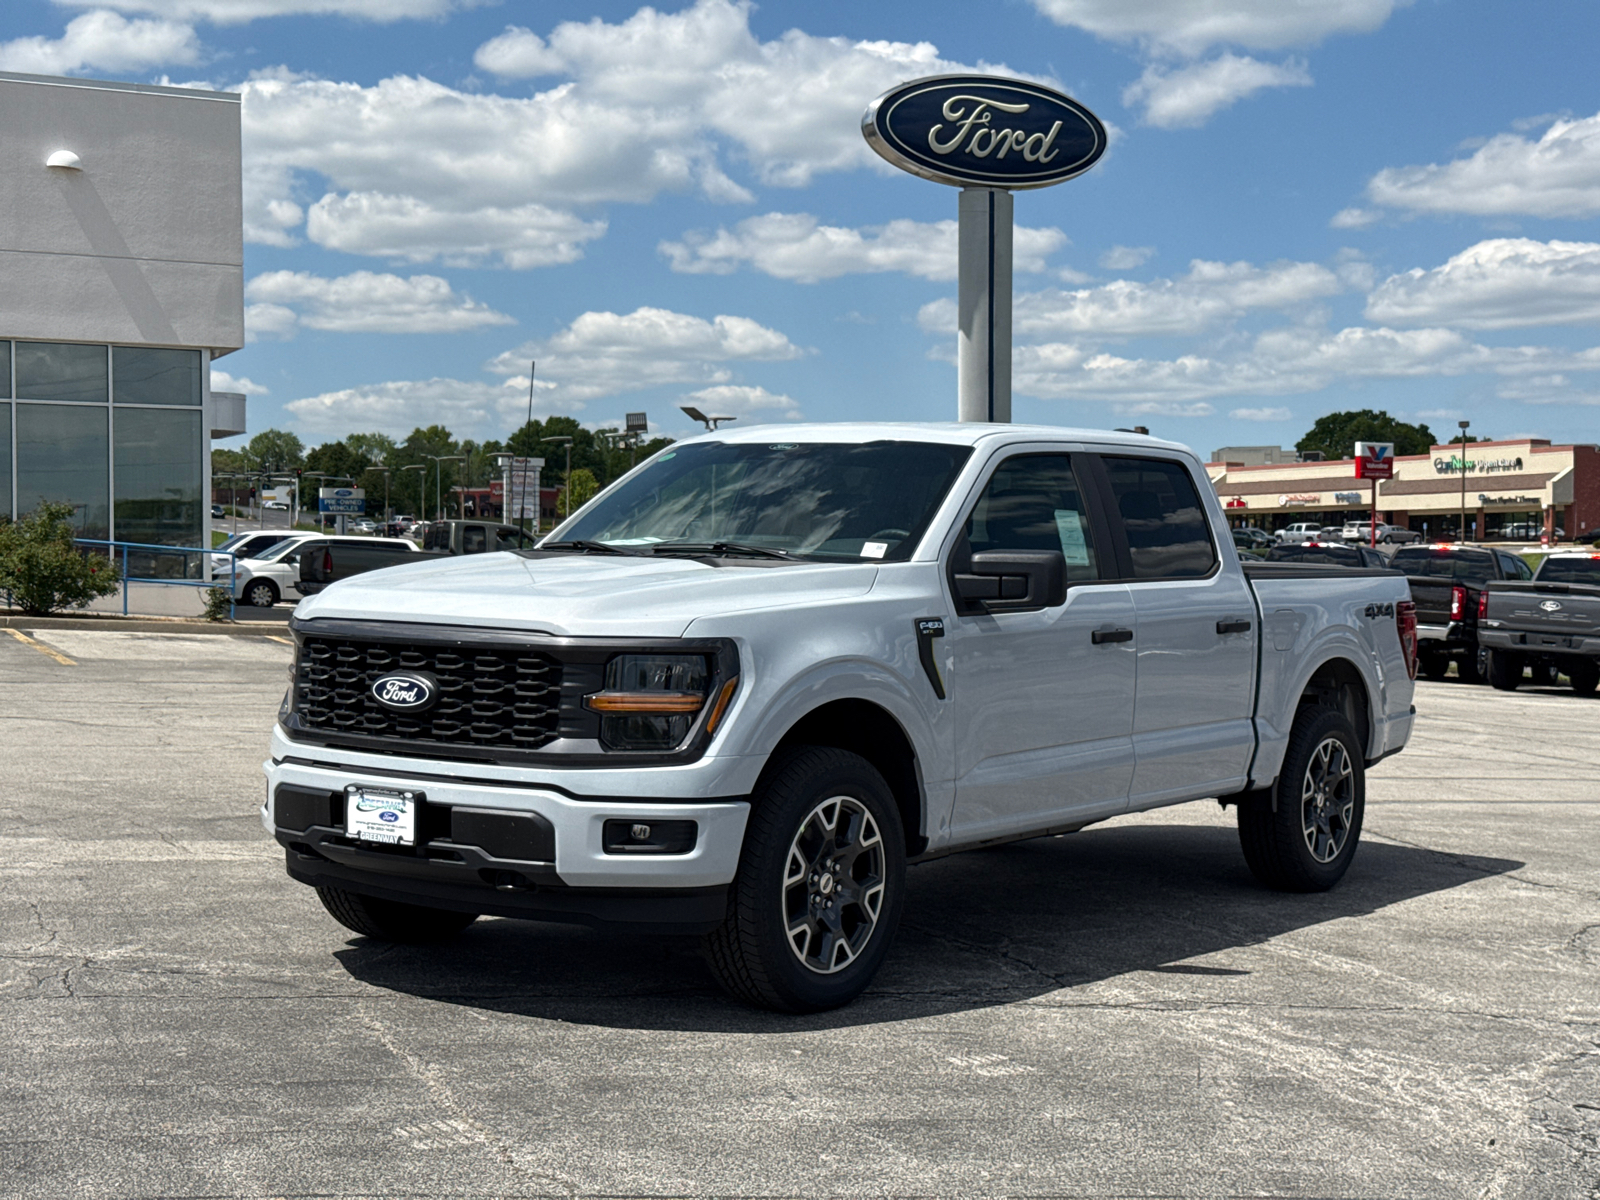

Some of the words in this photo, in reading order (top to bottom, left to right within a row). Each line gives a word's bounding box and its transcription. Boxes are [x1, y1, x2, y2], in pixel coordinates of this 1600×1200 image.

[928, 94, 1063, 164] Ford
[382, 681, 418, 702] Ford
[382, 812, 396, 821] Ford
[360, 831, 398, 844] GREENWAY
